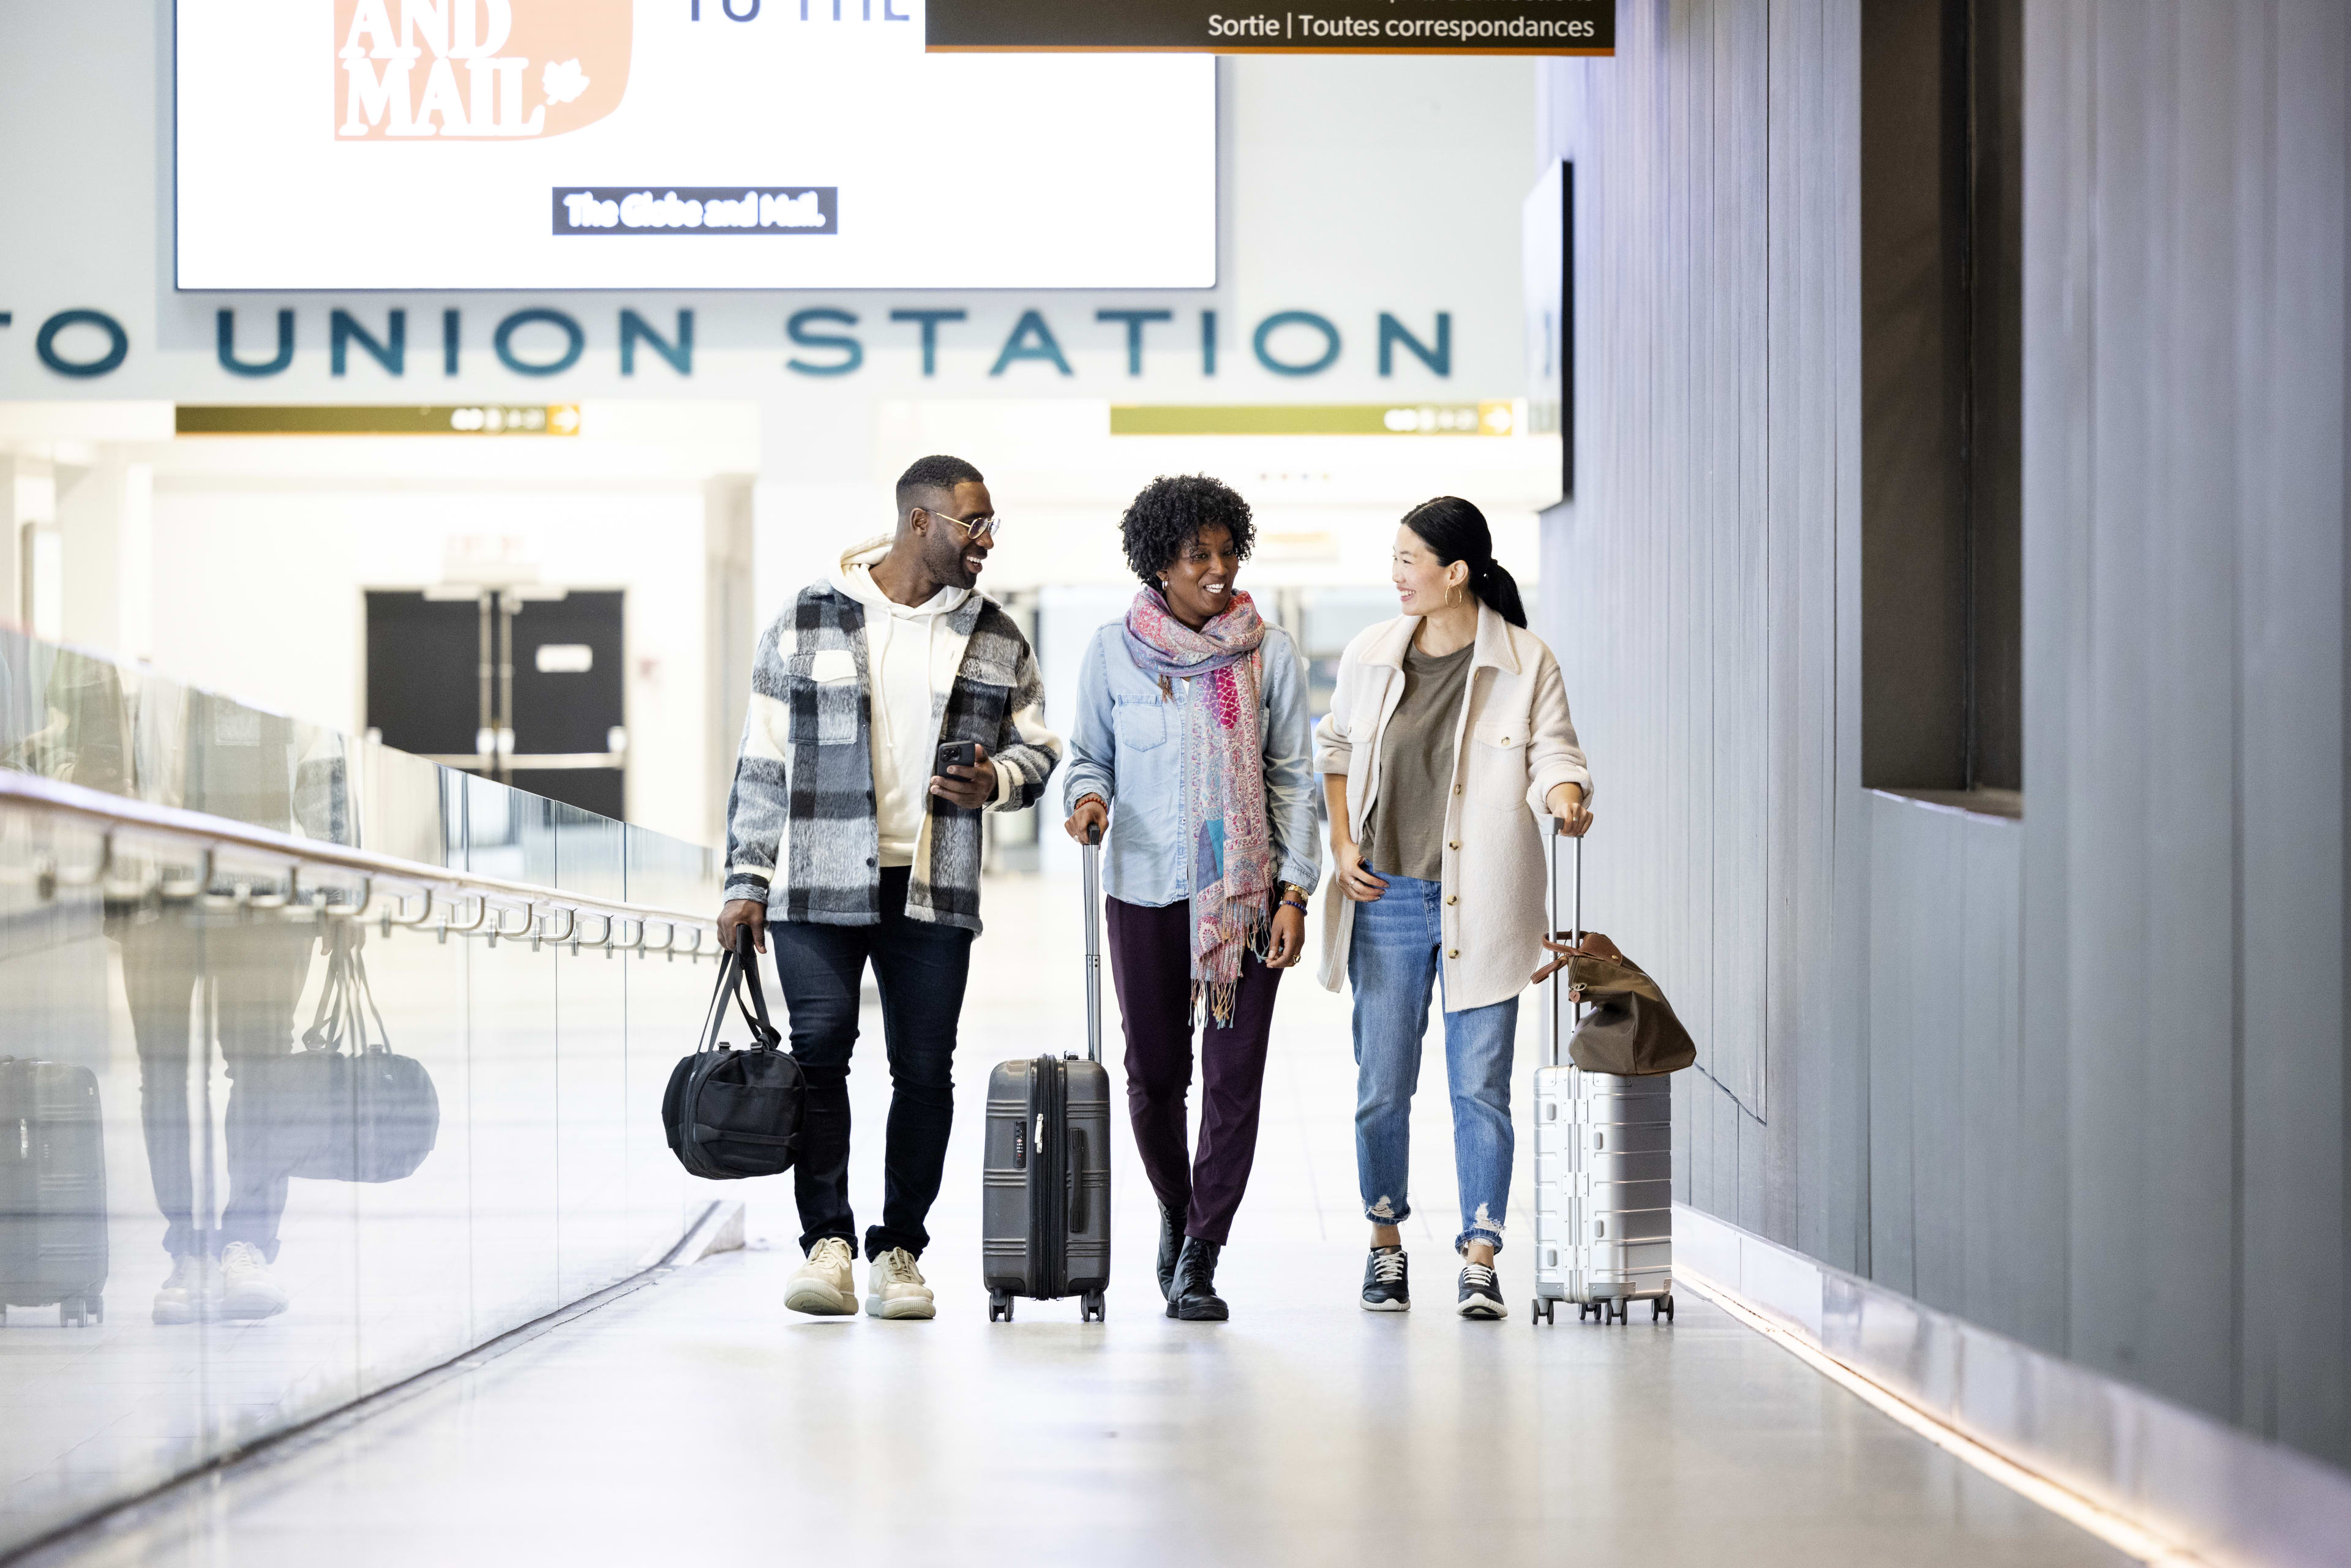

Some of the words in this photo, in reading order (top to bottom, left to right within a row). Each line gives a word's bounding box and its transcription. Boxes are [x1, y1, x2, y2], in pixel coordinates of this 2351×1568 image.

[339, 0, 512, 59] AND
[1207, 14, 1280, 37] Sortie
[1298, 15, 1380, 37] Toutes
[1385, 16, 1594, 41] correspondances
[339, 57, 546, 136] MAIL
[563, 190, 619, 227] The
[620, 190, 703, 227] Globe
[703, 190, 759, 227] and
[217, 309, 694, 377] UNION
[786, 308, 1451, 377] STATION
